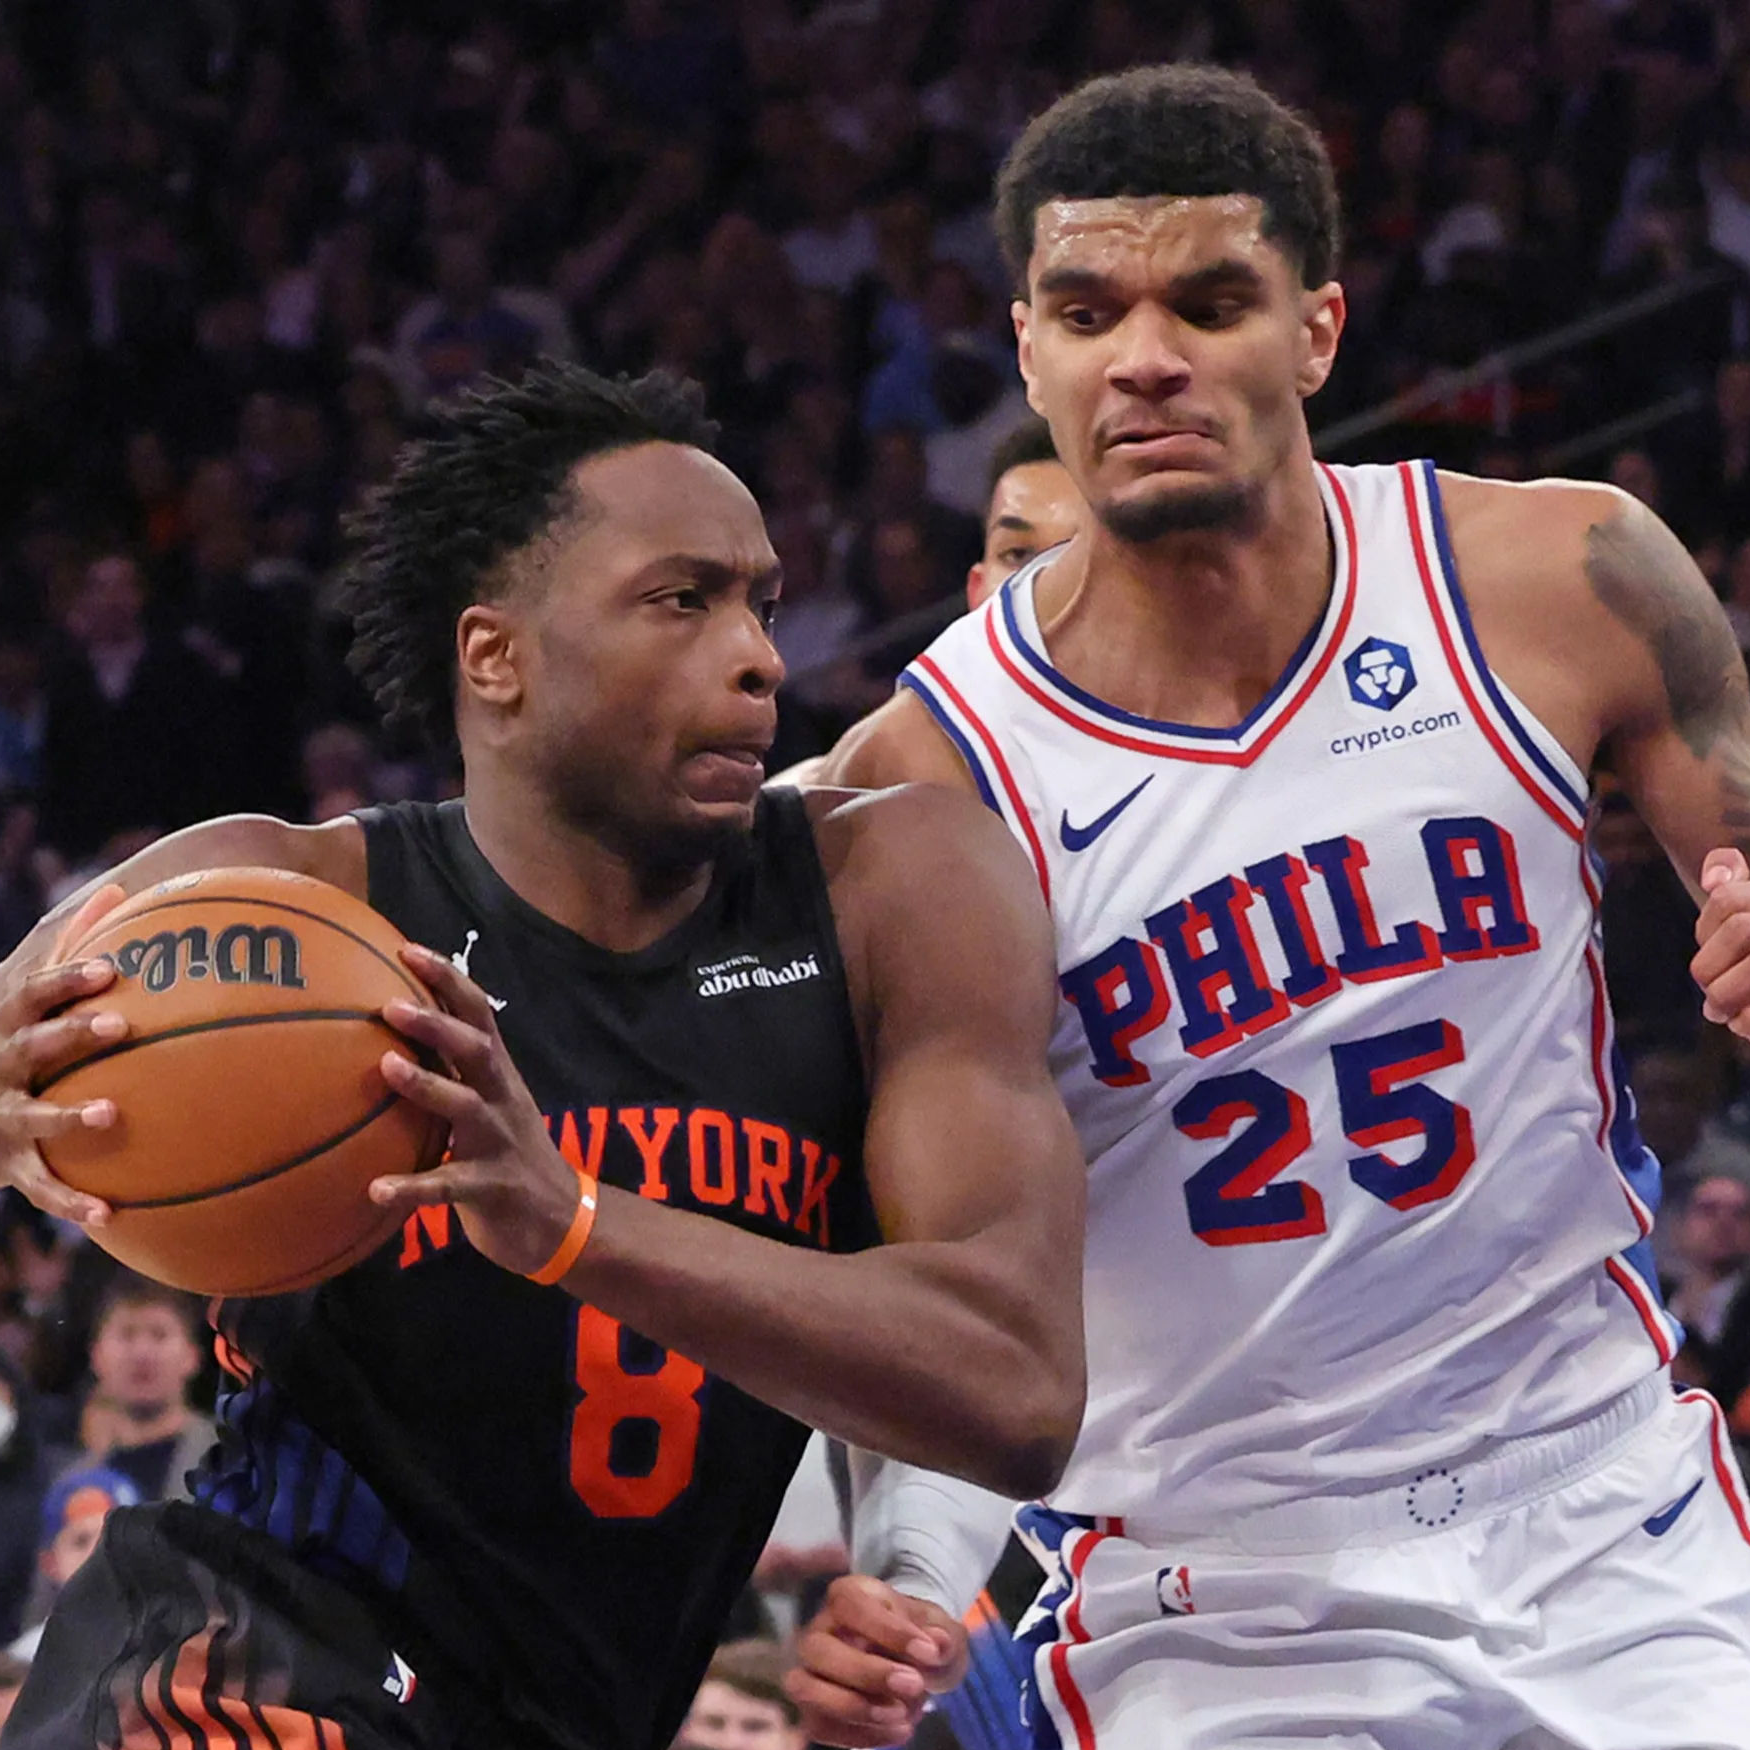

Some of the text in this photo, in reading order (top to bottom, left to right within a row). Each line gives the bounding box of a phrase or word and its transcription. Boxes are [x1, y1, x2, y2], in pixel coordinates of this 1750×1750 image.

[1330, 710, 1462, 755] crypto.com
[101, 923, 307, 992] Wils
[698, 969, 751, 997] abu
[1059, 816, 1541, 1087] PHILA
[1172, 1018, 1476, 1247] 25
[569, 1303, 705, 1518] 8
